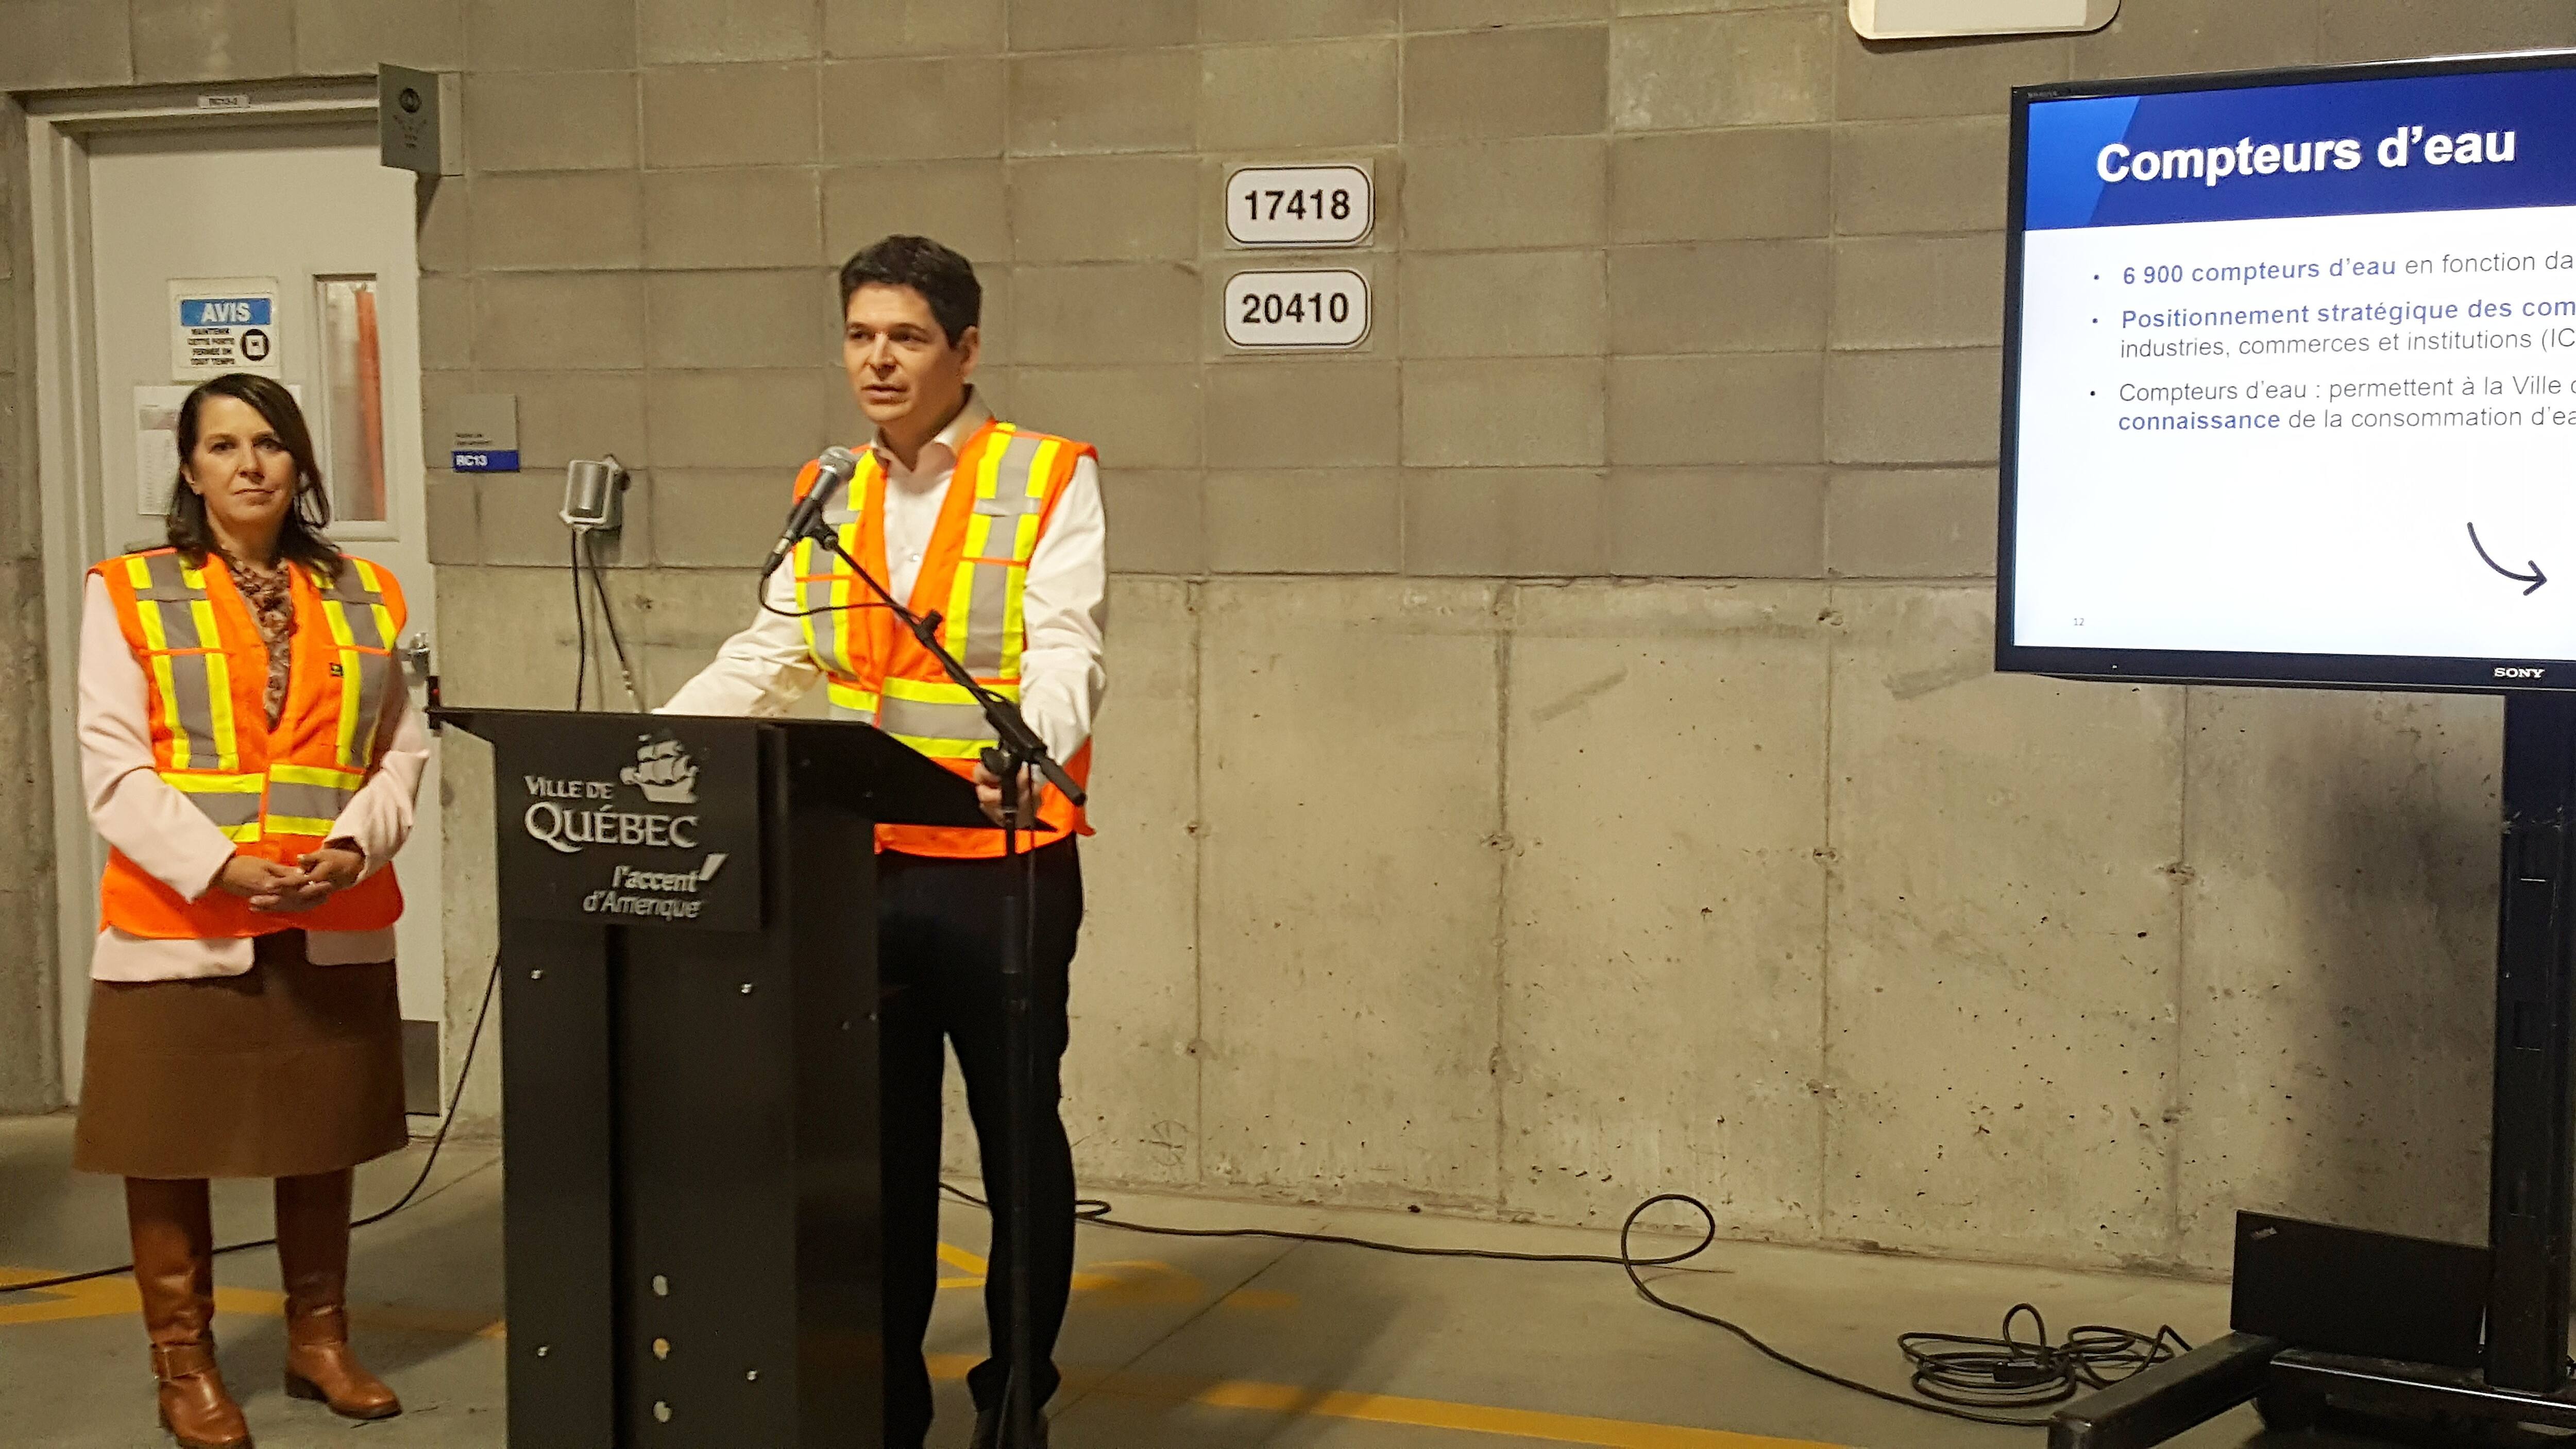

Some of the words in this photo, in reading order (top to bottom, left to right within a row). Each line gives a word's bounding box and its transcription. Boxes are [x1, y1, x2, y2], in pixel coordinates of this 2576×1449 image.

[2097, 136, 2362, 187] Compteurs
[2377, 126, 2516, 168] d'eau
[1245, 189, 1350, 220] 17418
[2123, 266, 2136, 285] 6
[2143, 264, 2183, 284] 900
[2191, 261, 2320, 286] compteurs
[2329, 257, 2396, 277] d'eau
[2405, 259, 2433, 275] en
[2442, 252, 2535, 274] fonction
[2545, 250, 2573, 270] da
[201, 301, 251, 322] AVIS
[1242, 293, 1348, 324] 20410
[2122, 304, 2310, 329] Positionnement
[2317, 300, 2459, 326] stratégique
[2467, 299, 2513, 318] des
[2521, 300, 2576, 317] com
[2121, 338, 2230, 359] industries,
[2239, 337, 2370, 355] commerces
[2378, 333, 2400, 351] et
[2408, 329, 2532, 351] institutions
[2541, 327, 2576, 353] (IC
[2119, 382, 2238, 406] Compteurs
[2245, 380, 2307, 400] d'eau
[2329, 378, 2454, 403] permettent
[2461, 376, 2475, 396] à
[2484, 376, 2503, 396] la
[2512, 375, 2562, 395] Ville
[2118, 411, 2281, 431] connaissance
[2288, 409, 2316, 429] de
[2324, 408, 2343, 428] la
[2351, 406, 2522, 428] consommation
[2074, 618, 2084, 626] 12
[2495, 668, 2545, 678] SONY
[524, 775, 583, 797] VILLE
[586, 781, 615, 799] DE
[524, 801, 698, 853] QUÉBEC
